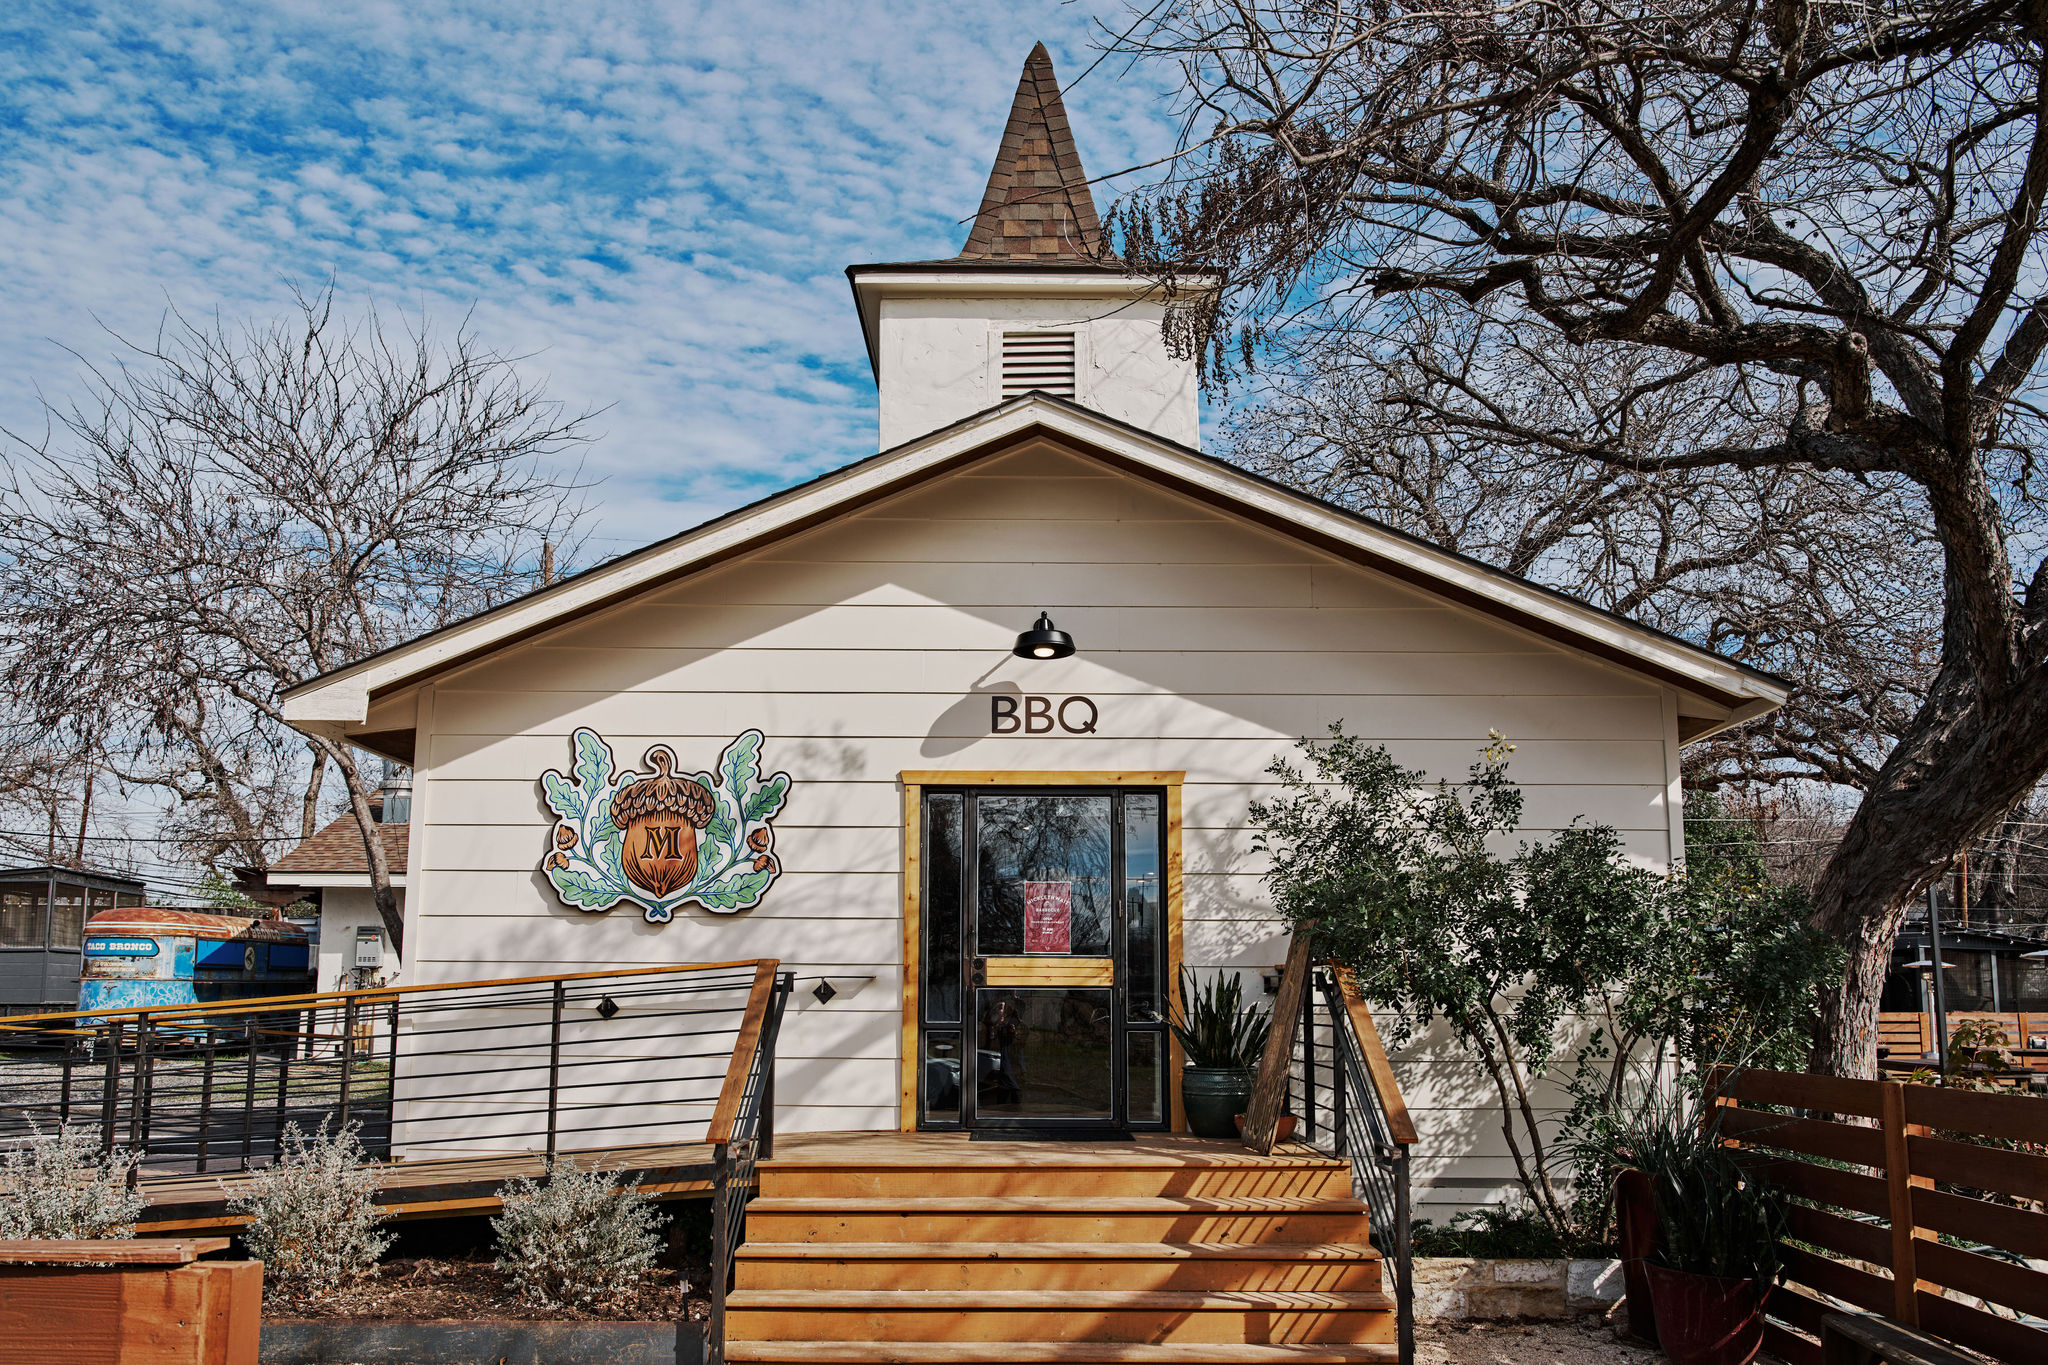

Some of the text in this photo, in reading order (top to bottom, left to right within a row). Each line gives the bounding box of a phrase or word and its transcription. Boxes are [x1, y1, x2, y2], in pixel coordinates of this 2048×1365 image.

[991, 695, 1098, 735] BBQ
[641, 825, 683, 861] M
[227, 925, 281, 940] TACO BRONCO
[87, 942, 153, 951] TACO BRONCO
